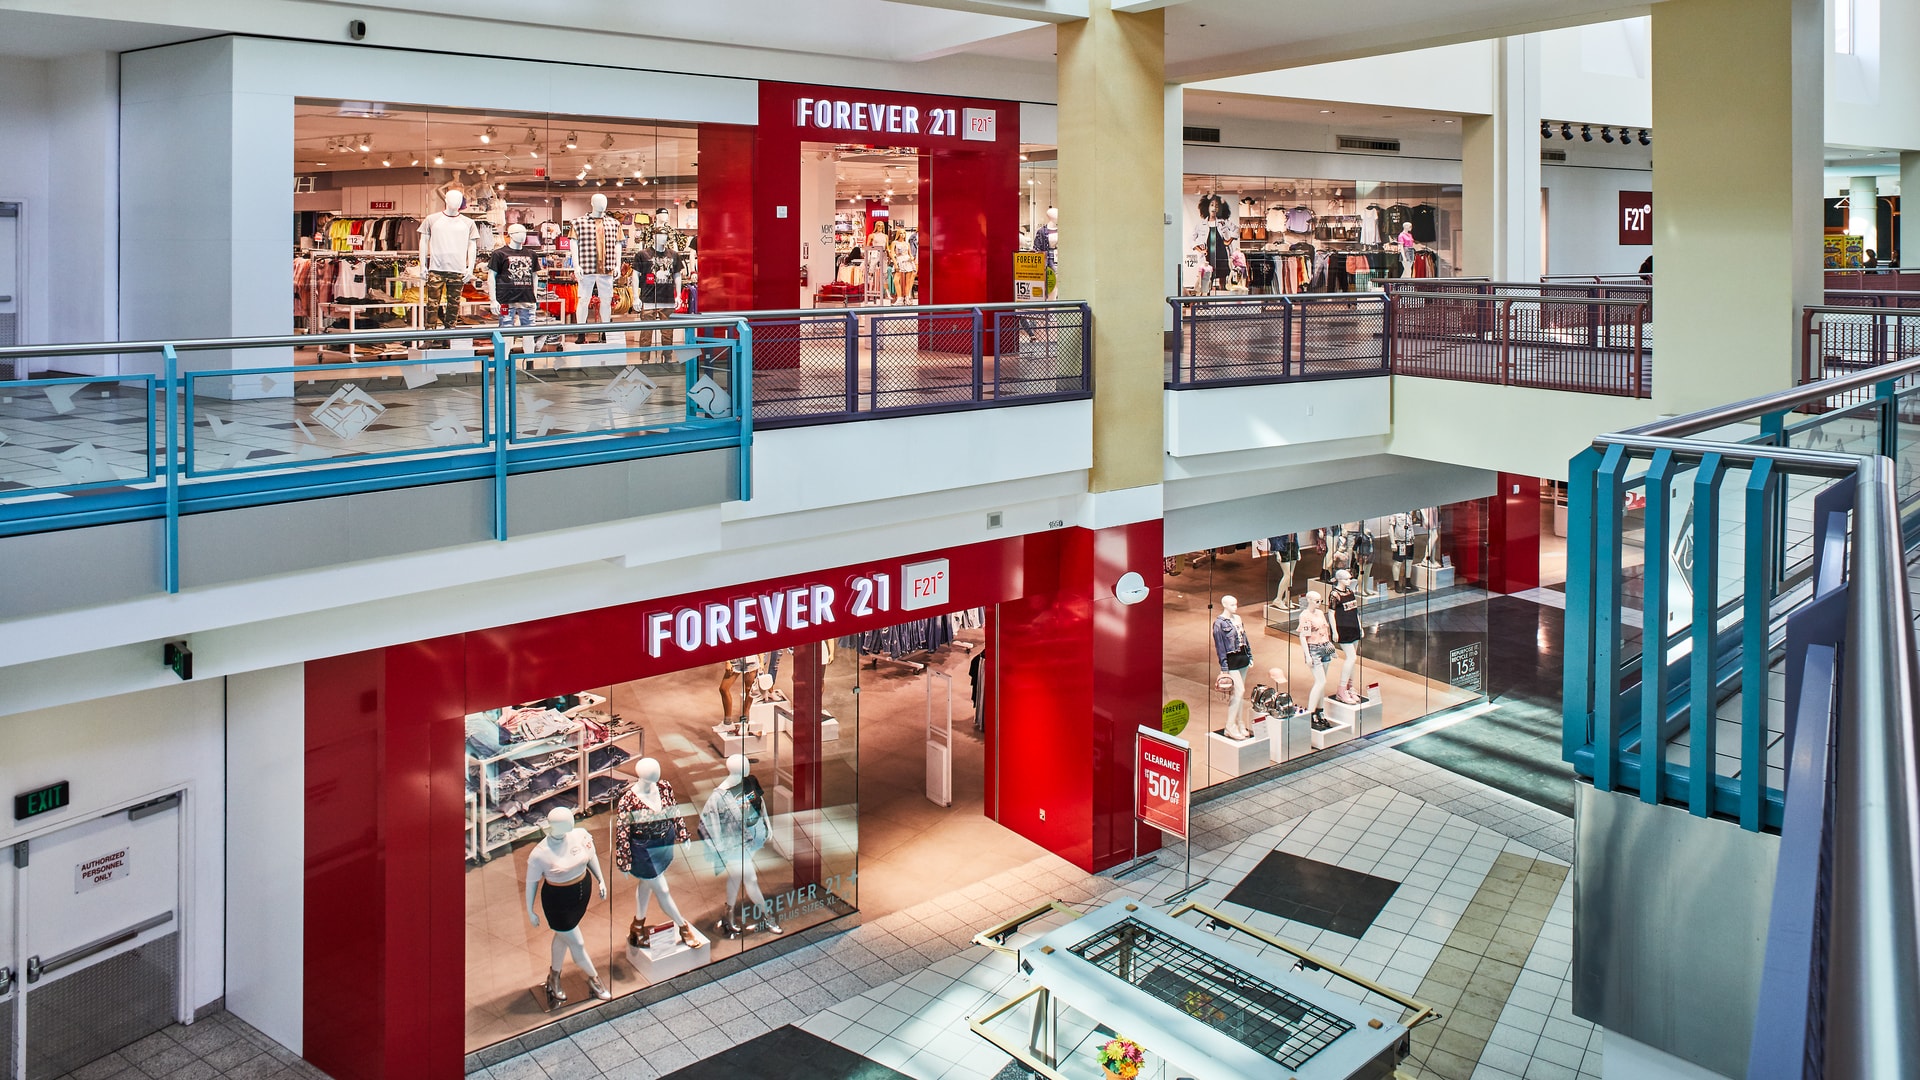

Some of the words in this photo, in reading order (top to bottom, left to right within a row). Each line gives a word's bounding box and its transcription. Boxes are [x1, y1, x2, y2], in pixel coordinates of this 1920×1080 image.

[797, 98, 919, 133] FOREVER
[929, 108, 956, 136] 21
[971, 117, 988, 132] F21
[1624, 207, 1645, 231] F21
[1016, 255, 1042, 264] FOREVER
[914, 576, 936, 598] F21
[649, 584, 836, 658] FOREVER
[851, 573, 890, 617] 21
[1163, 703, 1185, 714] FOREVER
[1144, 752, 1181, 772] CLEARANCE
[1148, 769, 1180, 801] 50%
[28, 786, 62, 815] EXIT
[81, 851, 125, 871] AUTHORIZED
[82, 860, 124, 880] PERSONNEL
[94, 872, 112, 883] ONLY
[742, 883, 817, 925] FOREVER
[825, 874, 841, 895] 21
[778, 908, 799, 923] PLUS
[802, 899, 825, 915] SIZES
